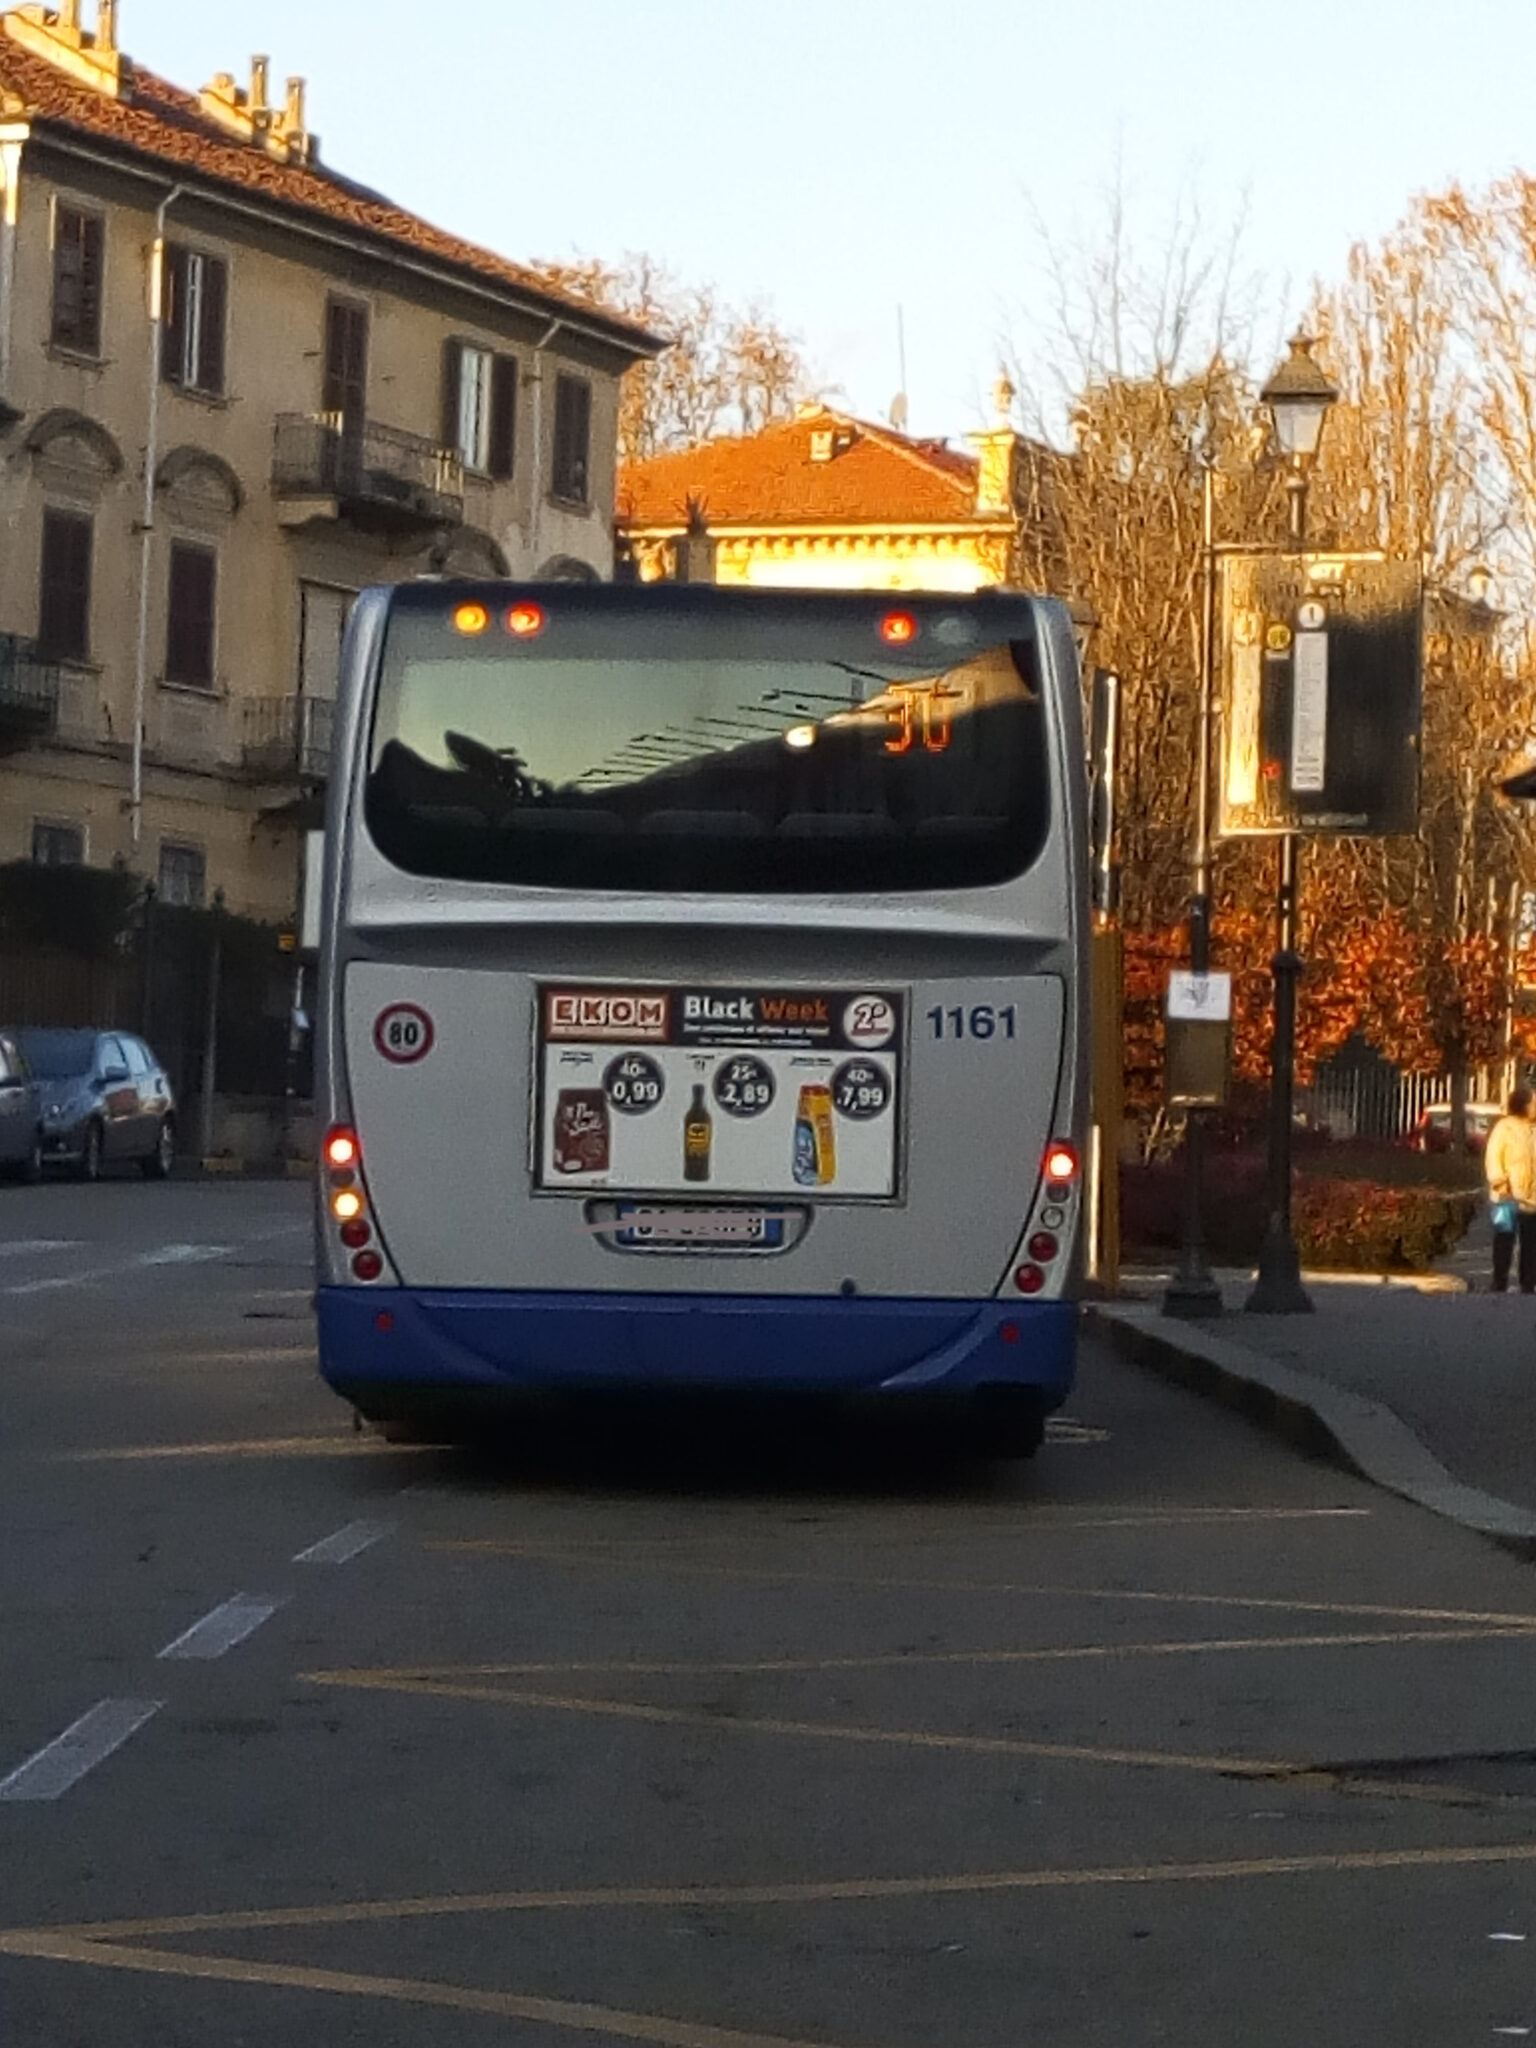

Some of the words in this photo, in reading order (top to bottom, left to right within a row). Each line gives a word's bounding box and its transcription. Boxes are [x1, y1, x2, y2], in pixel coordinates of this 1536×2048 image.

[553, 998, 663, 1026] EKOM
[684, 995, 754, 1019] Black
[760, 997, 829, 1021] Week
[389, 1021, 419, 1046] 80
[927, 1005, 1015, 1039] 1161
[613, 1081, 658, 1104] 0,99
[724, 1083, 769, 1106] 2,89
